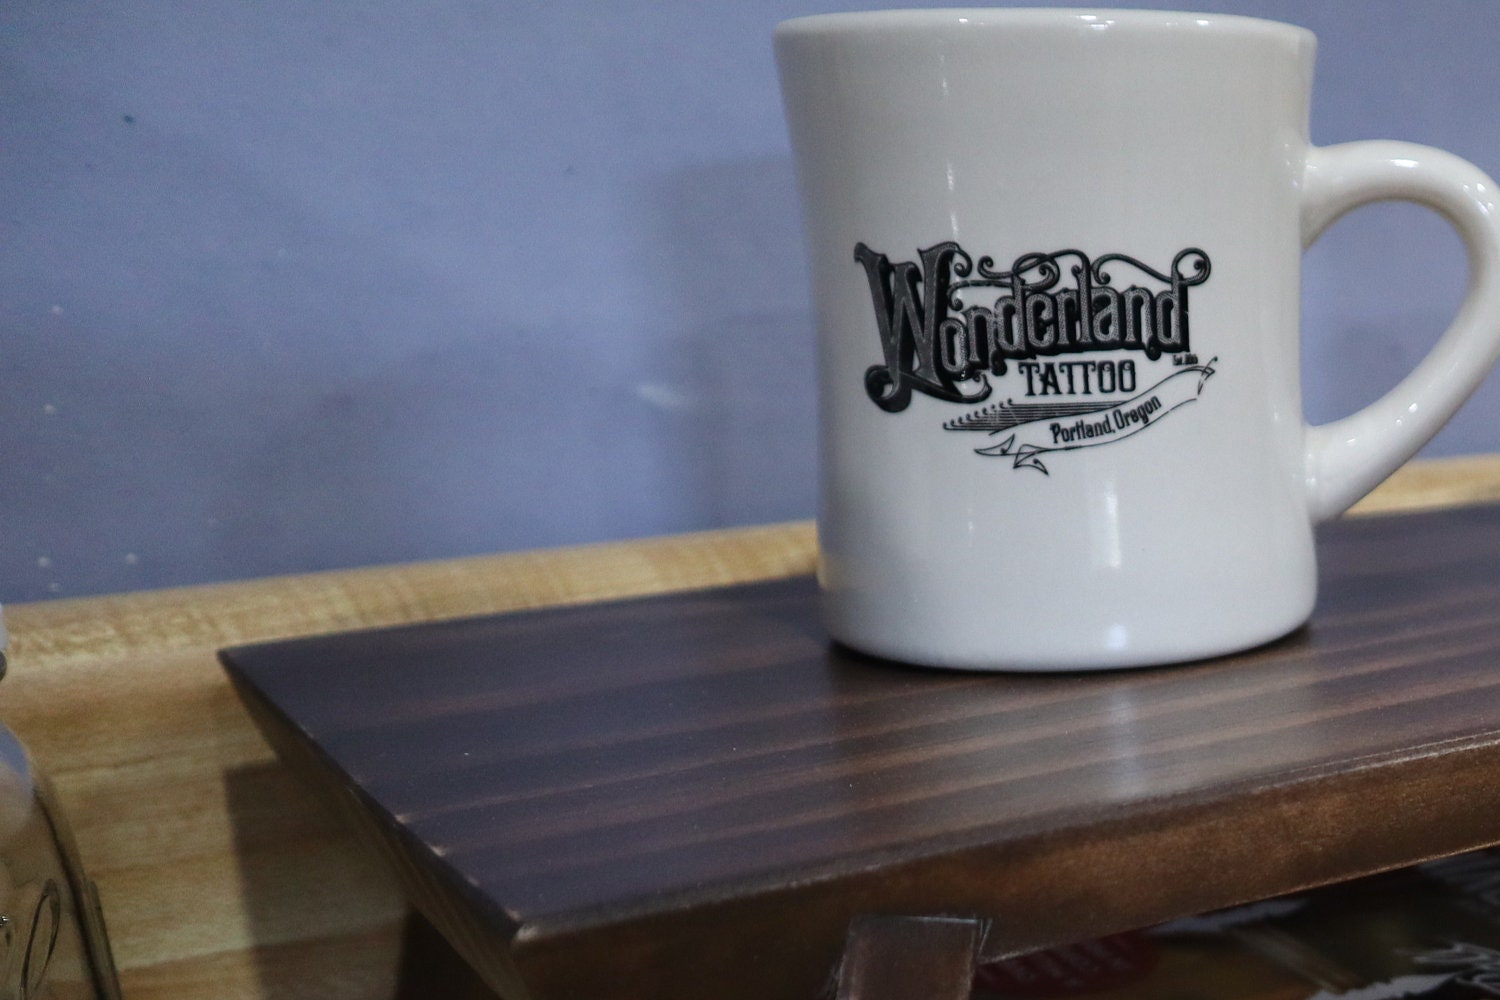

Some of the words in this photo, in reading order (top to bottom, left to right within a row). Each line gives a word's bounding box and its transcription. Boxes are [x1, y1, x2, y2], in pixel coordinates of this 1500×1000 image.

[854, 241, 1211, 413] Wonderland
[1018, 359, 1136, 397] TATTOO
[1049, 420, 1116, 445] Portland,
[1116, 395, 1162, 431] Oregon
